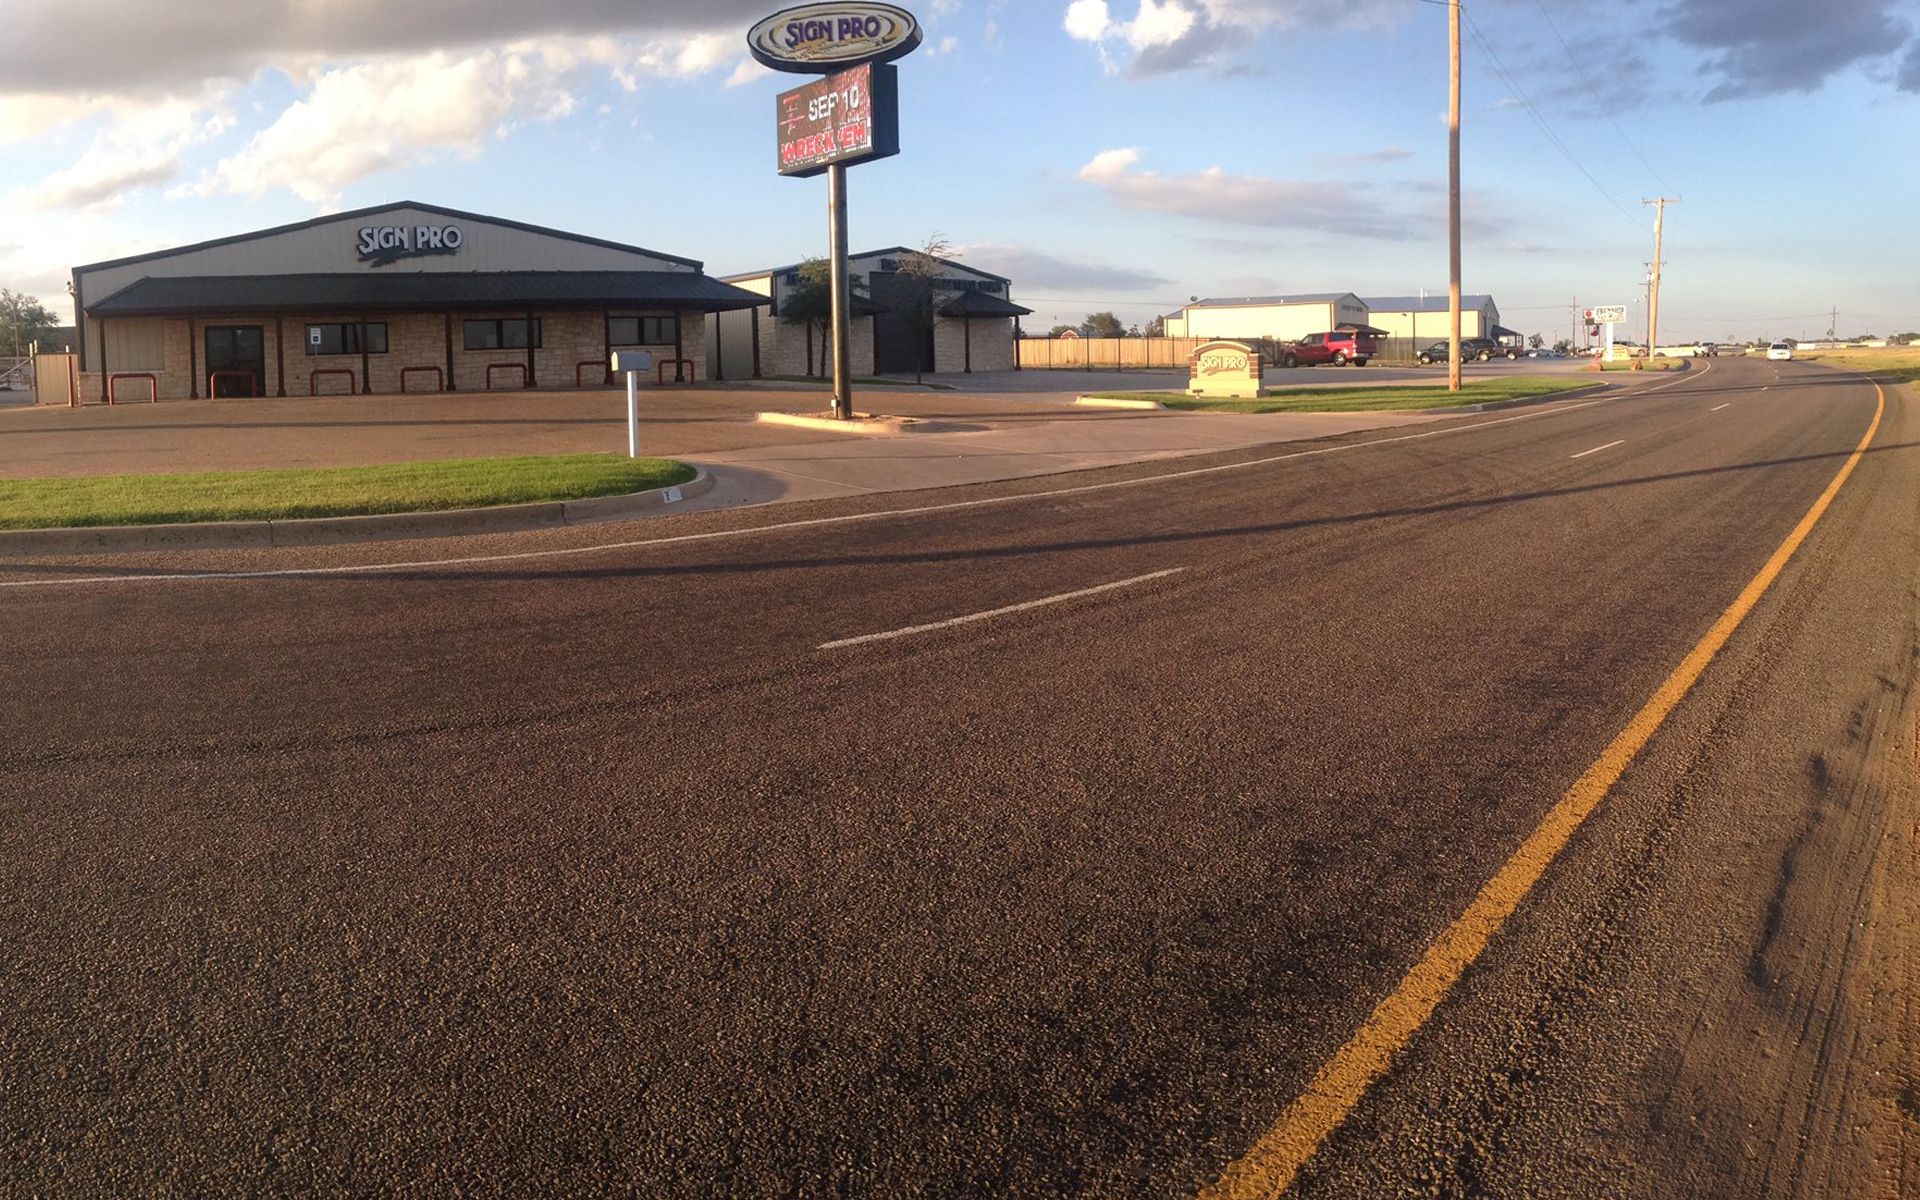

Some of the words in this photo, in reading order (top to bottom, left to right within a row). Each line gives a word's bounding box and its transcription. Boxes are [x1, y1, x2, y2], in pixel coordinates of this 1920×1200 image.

[785, 19, 834, 47] SIGN
[838, 15, 881, 41] PRO
[808, 92, 838, 121] SEP
[842, 85, 859, 111] 10
[359, 226, 409, 253] SIGN
[416, 226, 462, 249] PRO
[1224, 356, 1247, 369] PRO
